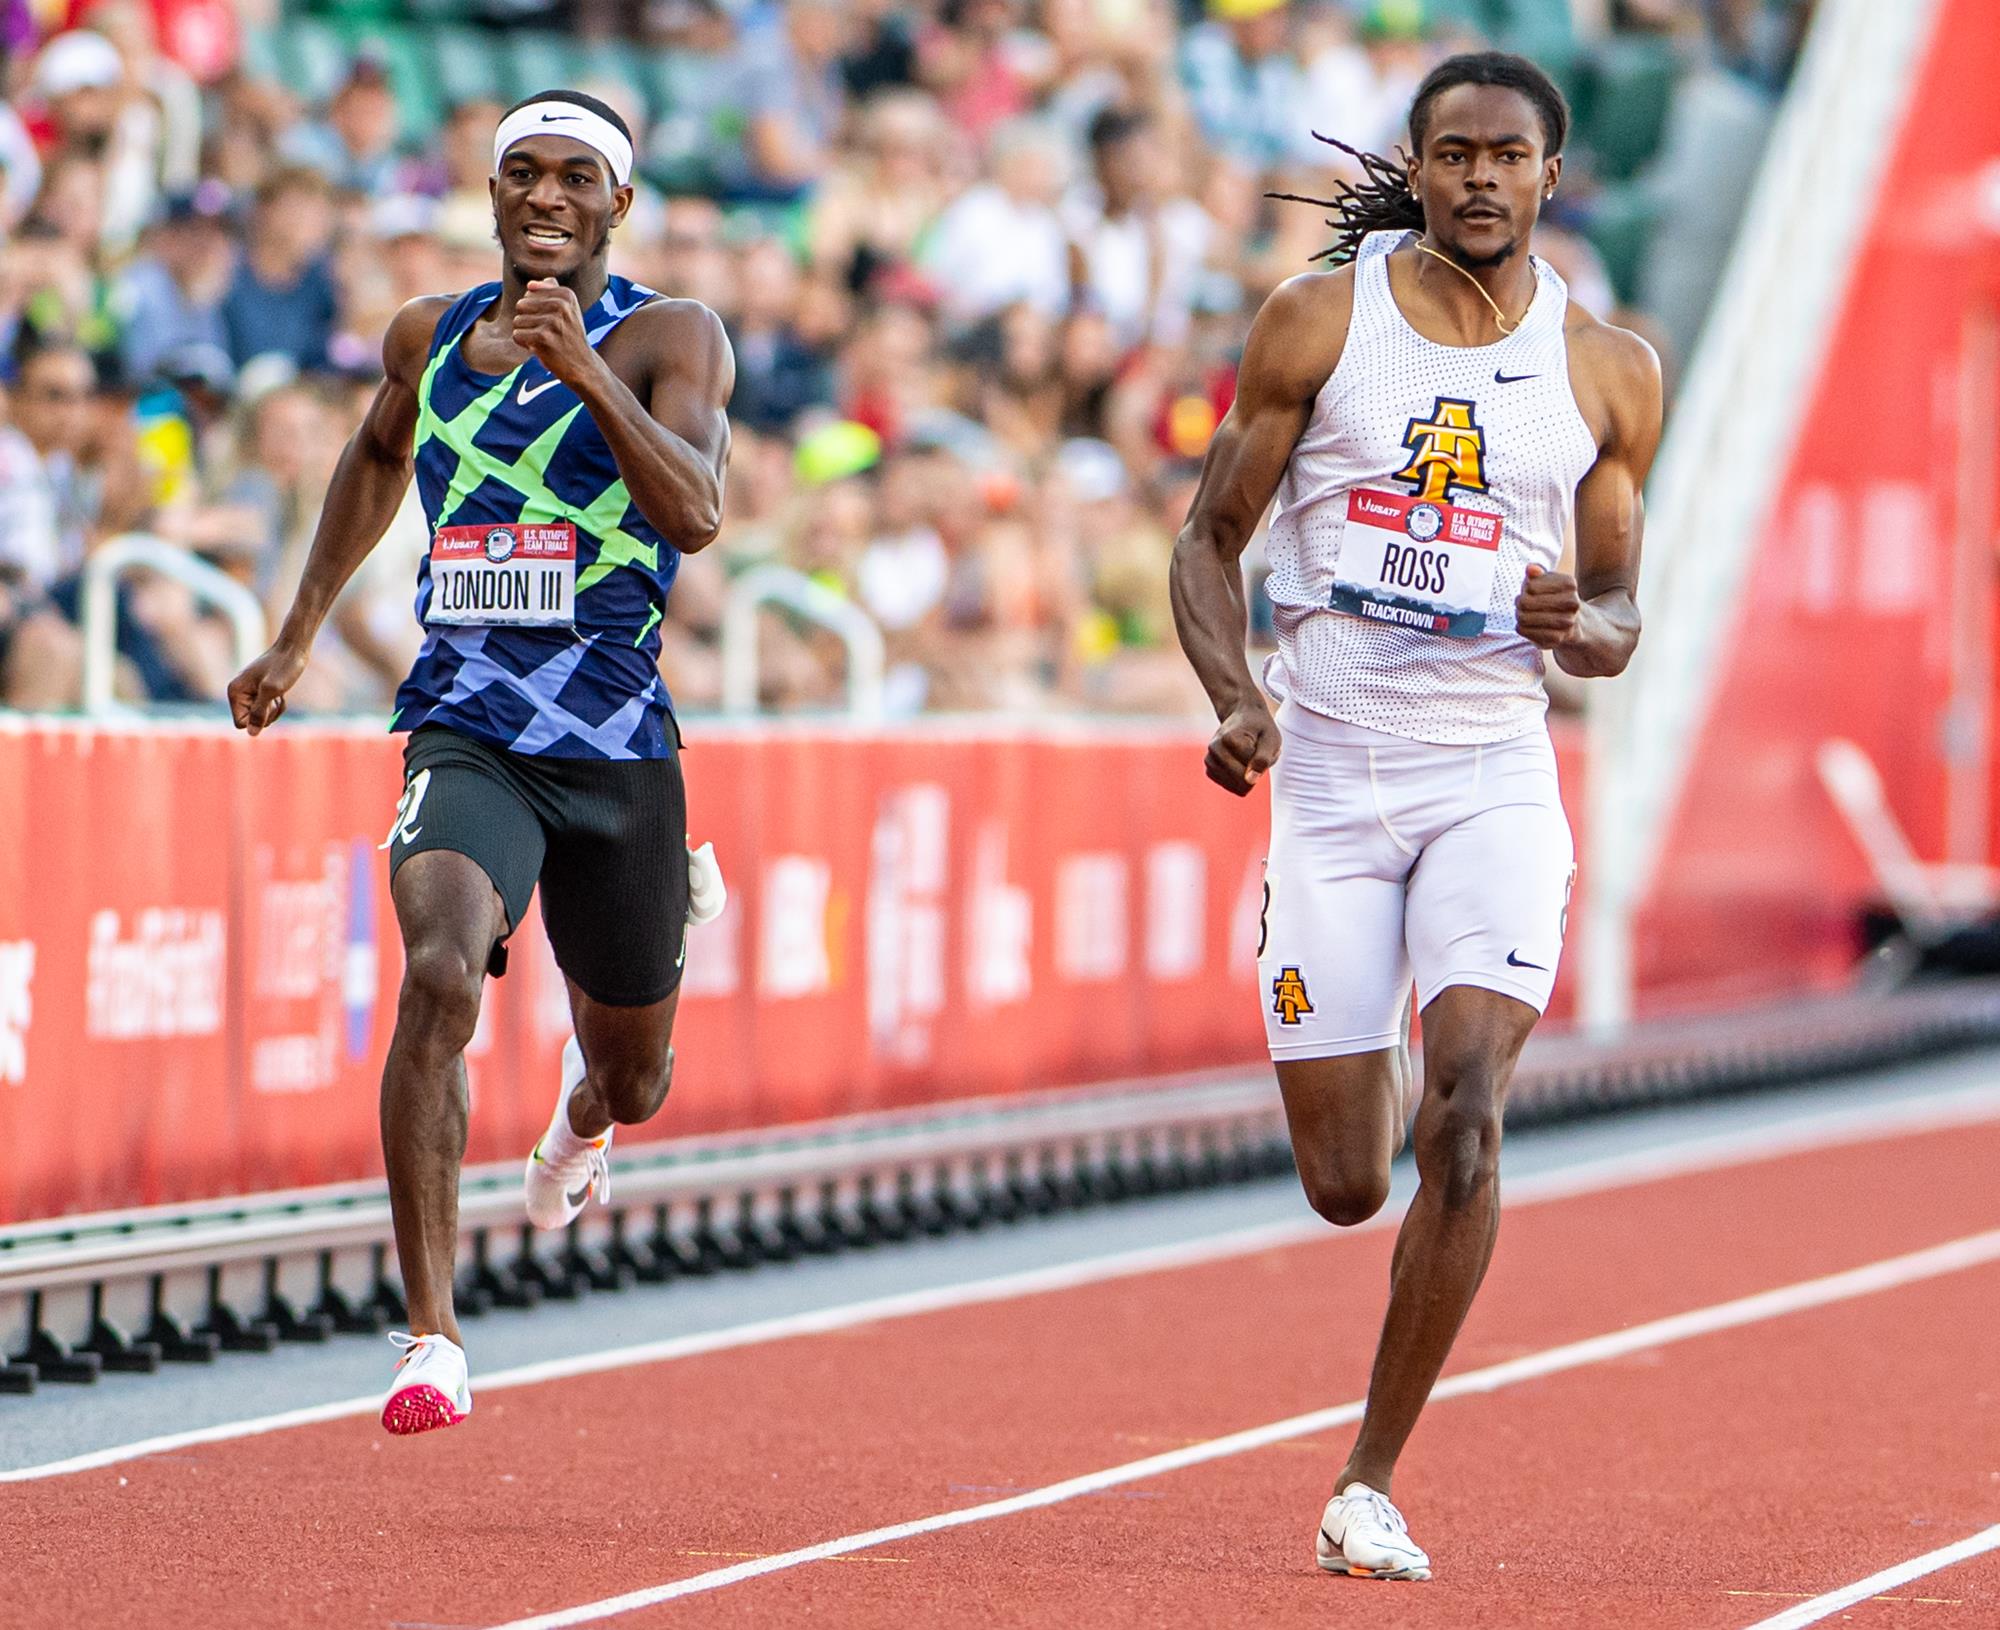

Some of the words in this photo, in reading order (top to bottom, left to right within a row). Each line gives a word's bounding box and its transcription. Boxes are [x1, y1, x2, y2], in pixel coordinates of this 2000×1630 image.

[1370, 503, 1401, 517] USATF
[1452, 512, 1466, 525] U.S.
[1466, 515, 1496, 531] OLYMPIC
[523, 529, 537, 540] U.S.
[539, 529, 569, 540] OLYMPIC
[1451, 524, 1471, 538] TEAM
[1470, 527, 1494, 542] TRIALS
[523, 540, 543, 551] TEAM
[544, 540, 568, 551] TRIALS
[1379, 542, 1450, 594] ROSS
[442, 570, 530, 610] LONDON
[540, 570, 562, 610] III
